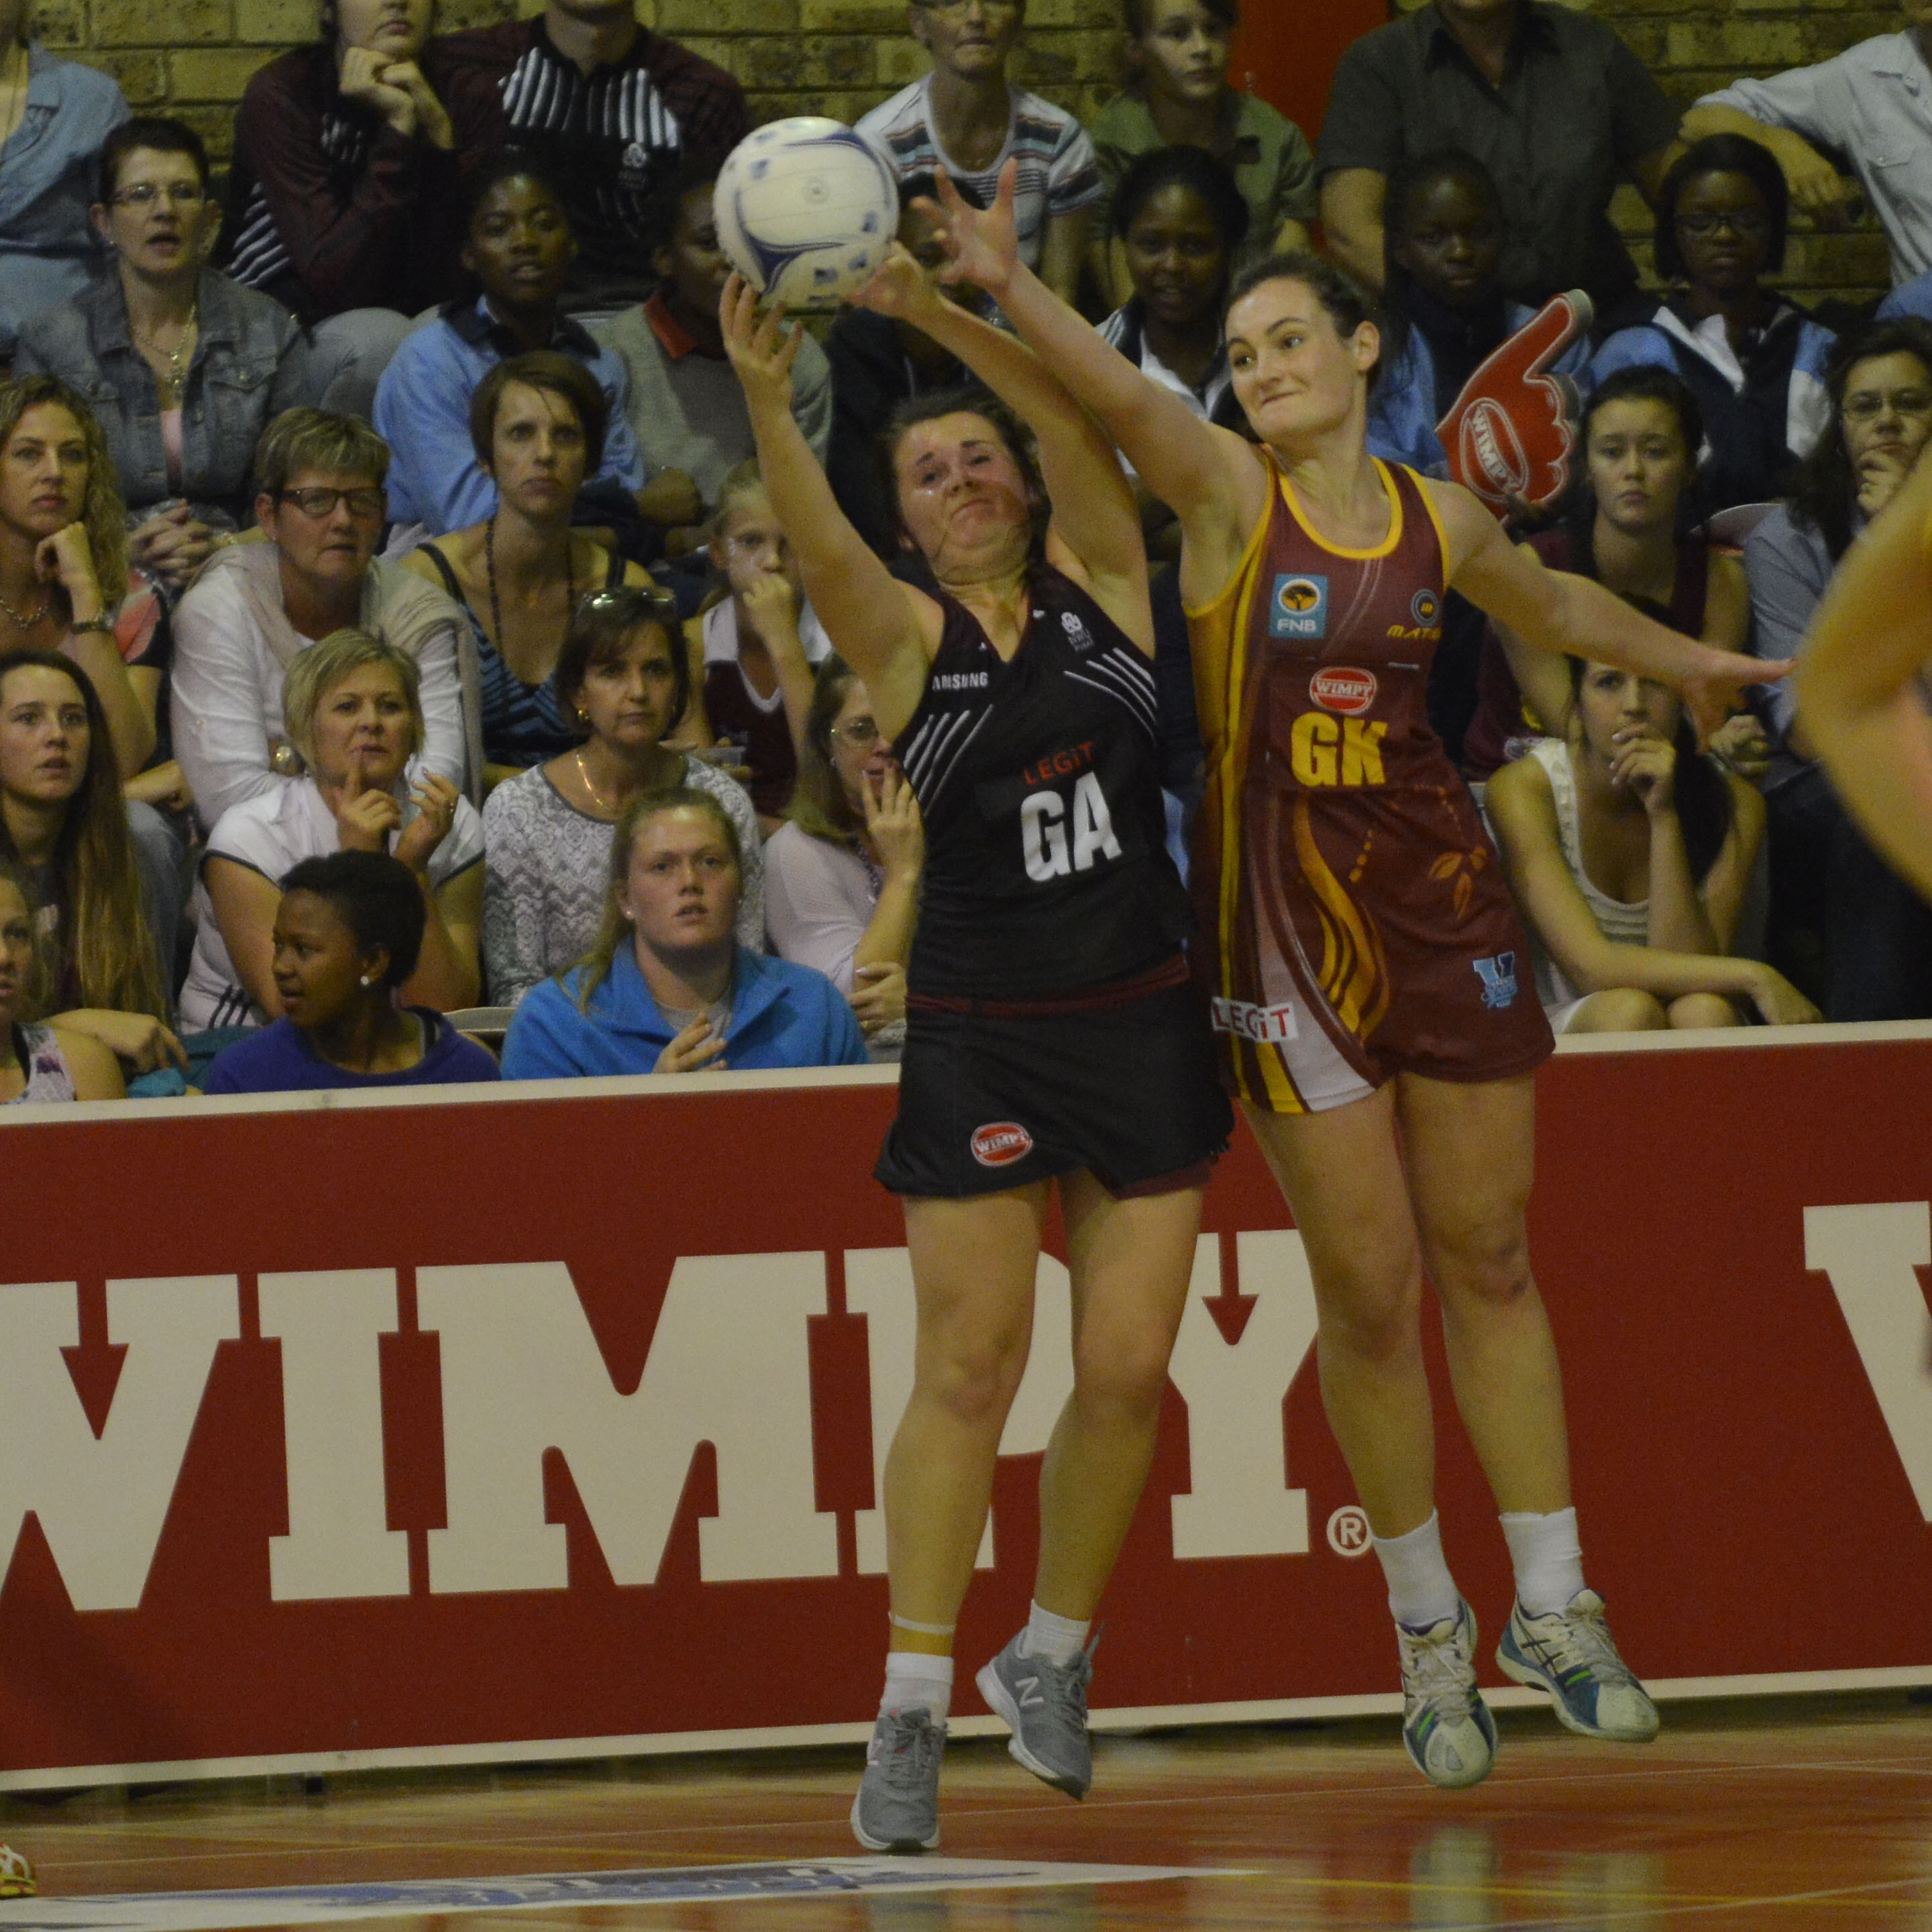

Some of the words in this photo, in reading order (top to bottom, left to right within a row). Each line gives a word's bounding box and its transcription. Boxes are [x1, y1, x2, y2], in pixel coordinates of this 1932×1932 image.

[1277, 617, 1316, 632] FNB
[1316, 680, 1373, 697] WIMPY
[1291, 711, 1388, 787] GK
[1020, 770, 1122, 881] GA
